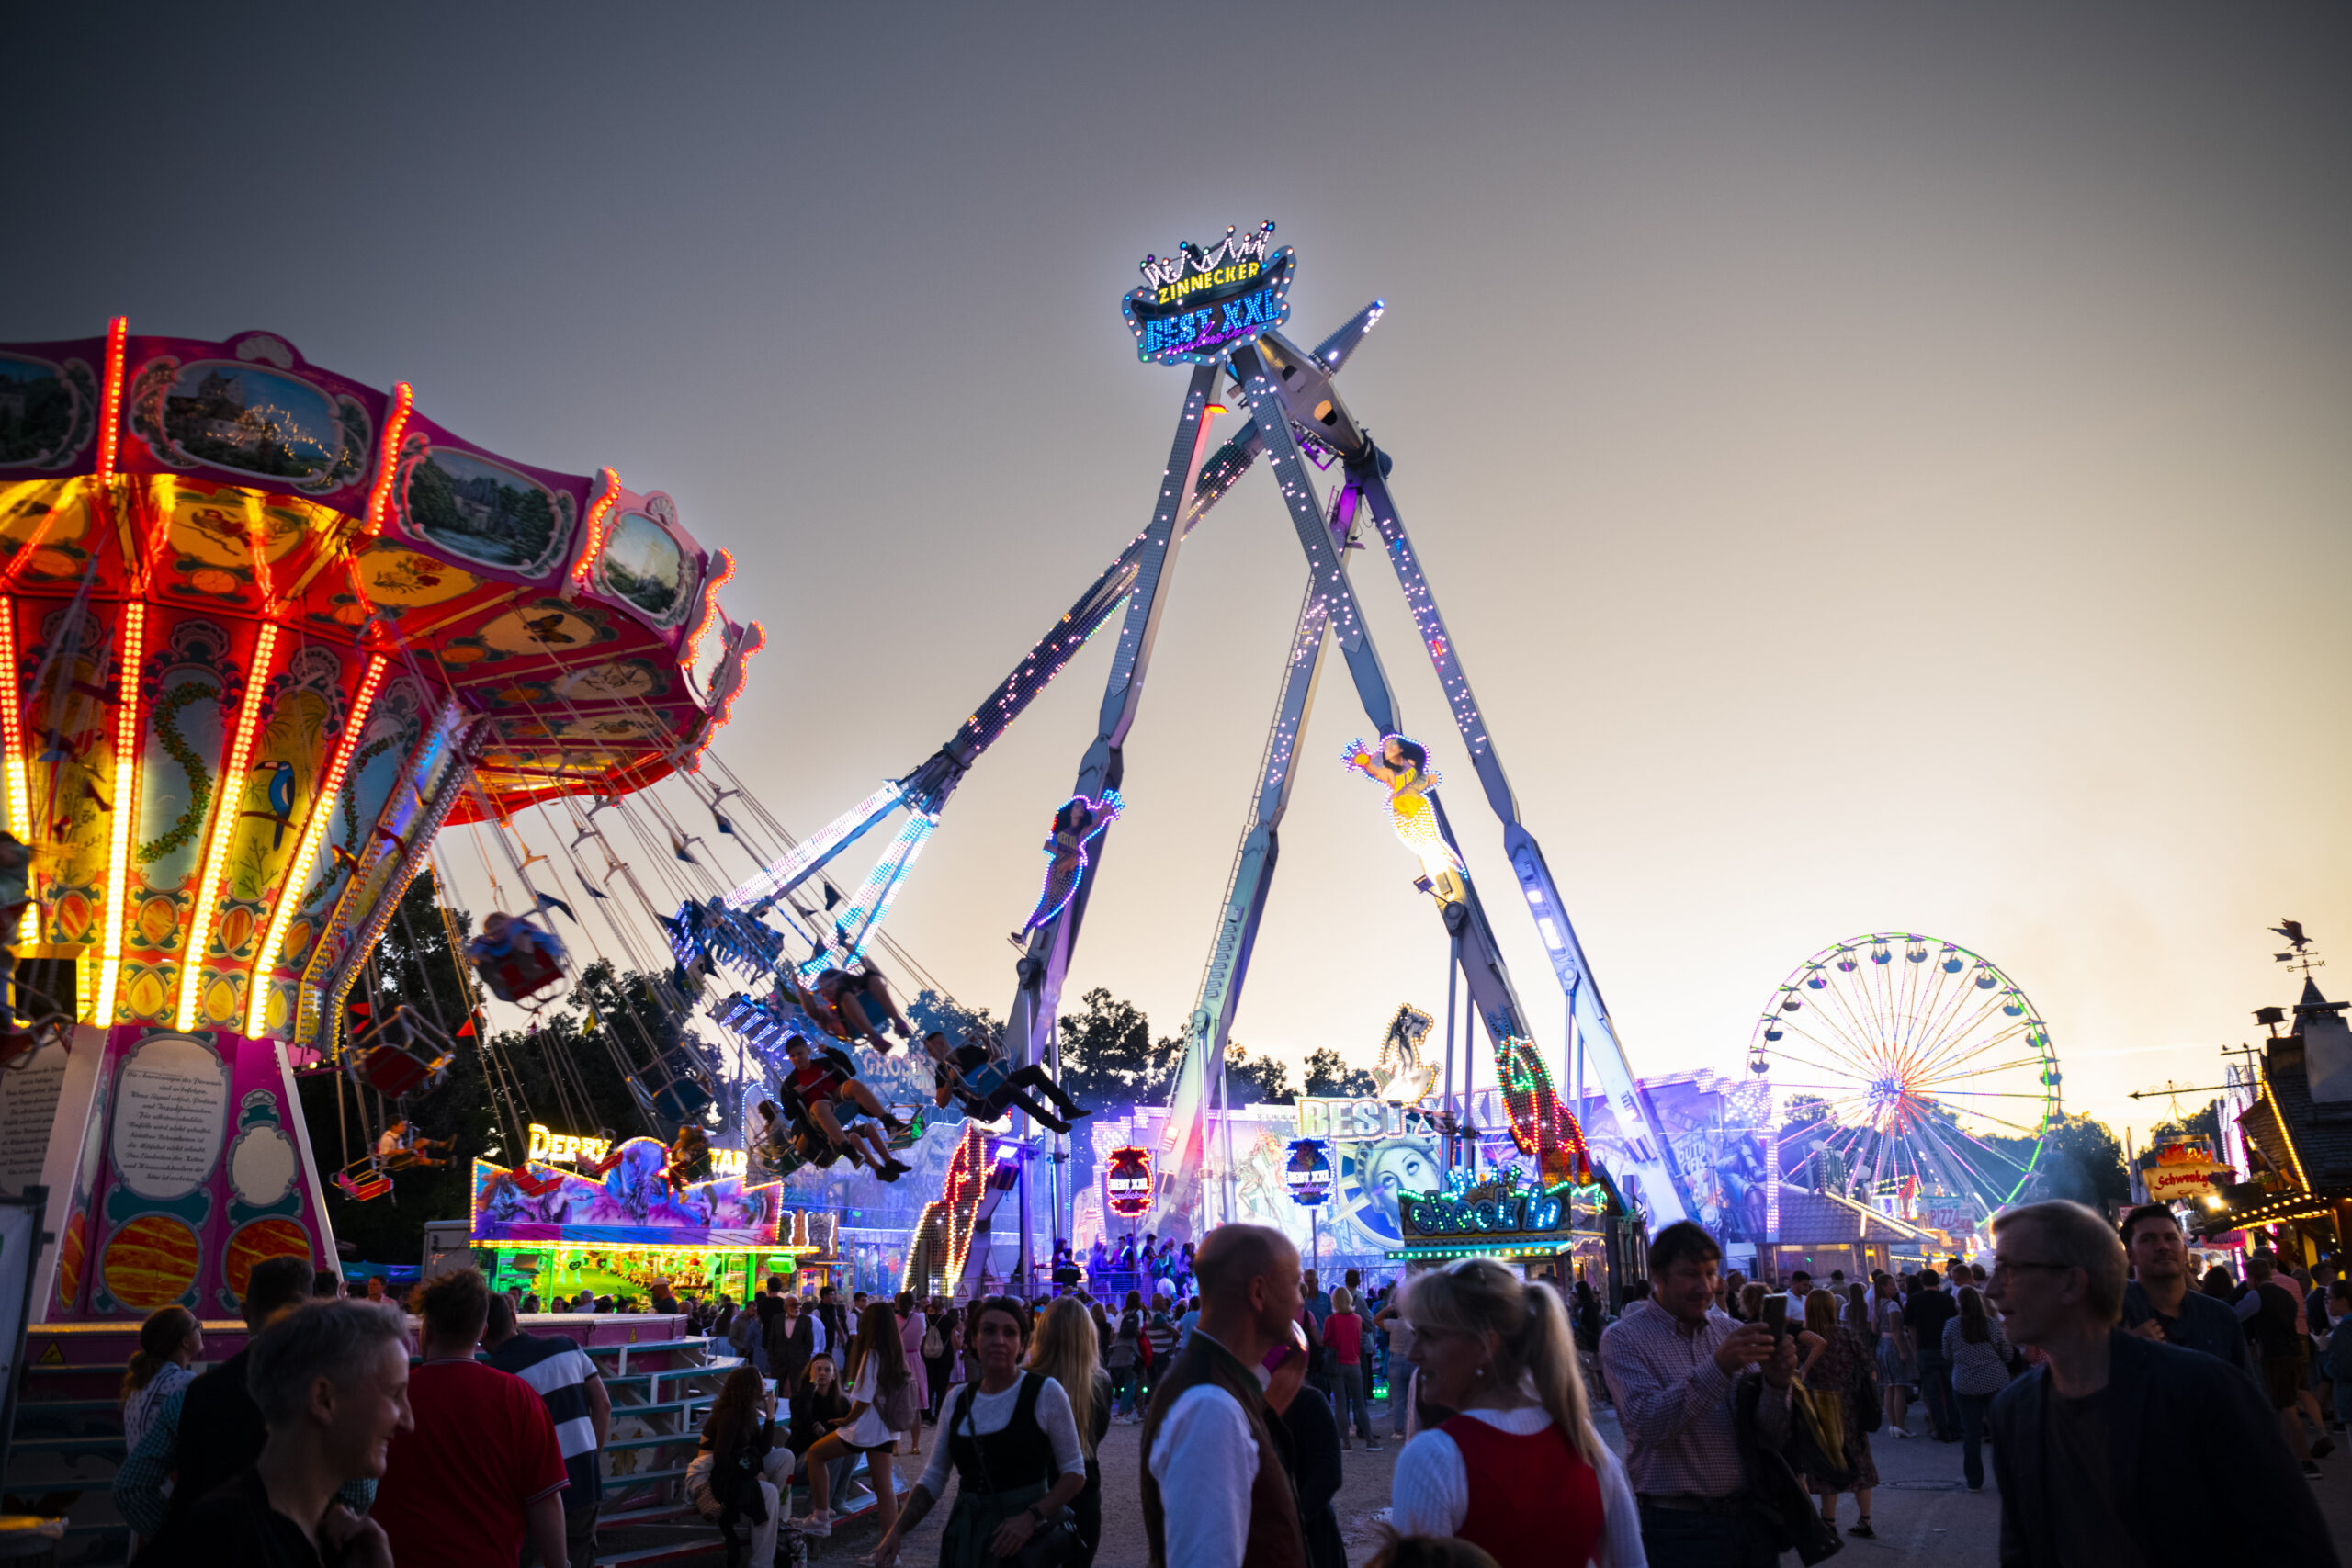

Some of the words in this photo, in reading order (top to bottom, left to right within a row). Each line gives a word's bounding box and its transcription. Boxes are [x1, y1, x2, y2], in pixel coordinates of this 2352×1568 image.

[1158, 262, 1260, 304] ZINNECKER
[1147, 307, 1212, 353] BEST
[1221, 288, 1280, 333] XXL
[864, 1052, 926, 1077] GHOST
[1301, 1099, 1401, 1137] BEST
[707, 1148, 749, 1175] TAR
[1679, 1139, 1706, 1164] OUTH
[1288, 1171, 1310, 1184] BEST
[1311, 1169, 1330, 1182] XXL
[1681, 1154, 1708, 1175] CIFIC
[1110, 1179, 1130, 1190] BEST
[1131, 1178, 1148, 1190] XXL
[2154, 1169, 2209, 1190] Schwenkg
[1409, 1186, 1521, 1235] check
[1522, 1182, 1561, 1231] in
[1929, 1208, 1960, 1228] PIZZA
